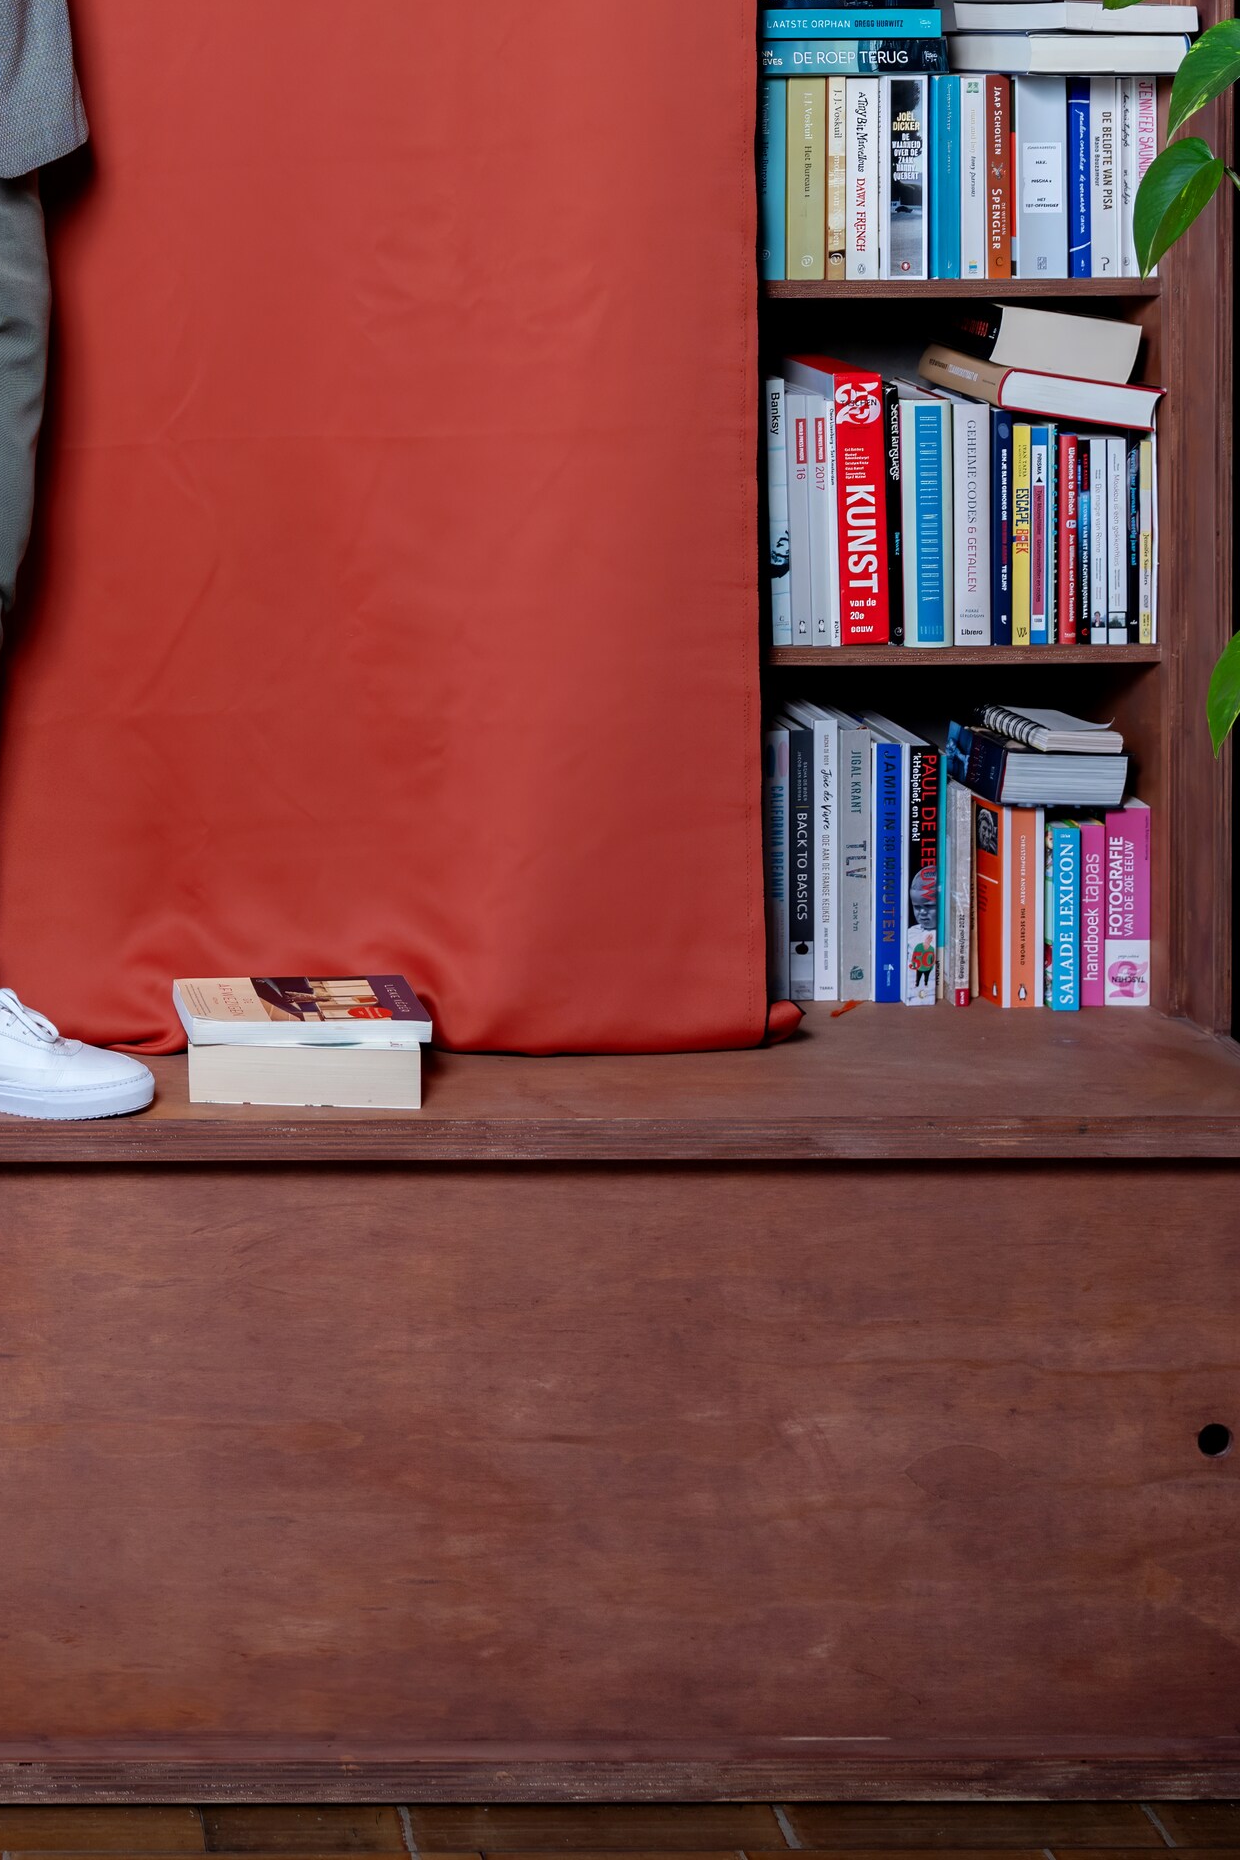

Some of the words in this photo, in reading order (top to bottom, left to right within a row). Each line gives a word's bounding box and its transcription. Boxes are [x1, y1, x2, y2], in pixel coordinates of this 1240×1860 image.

[793, 51, 812, 64] DE
[817, 51, 855, 64] ROEP
[859, 50, 909, 64] TERUG
[1102, 112, 1112, 123] DE
[1102, 126, 1112, 166] BELOFTE
[856, 178, 866, 207] DAWN
[1102, 168, 1112, 186] VAN
[1103, 189, 1113, 210] PISA
[854, 211, 866, 252] FRENCH
[967, 420, 977, 478] GEHEIME
[967, 481, 977, 524] CODES
[845, 484, 879, 593] KUNST
[967, 537, 977, 592] GETALLEN
[921, 754, 936, 800] PAUL
[921, 807, 936, 831] DE
[920, 838, 936, 901] LEEUW
[1060, 843, 1075, 926] LEXICON
[1082, 853, 1102, 903] tapas
[1109, 836, 1123, 936] FOTOGRAFIE
[1084, 908, 1099, 981] handboek
[1060, 933, 1074, 1005] SALADE
